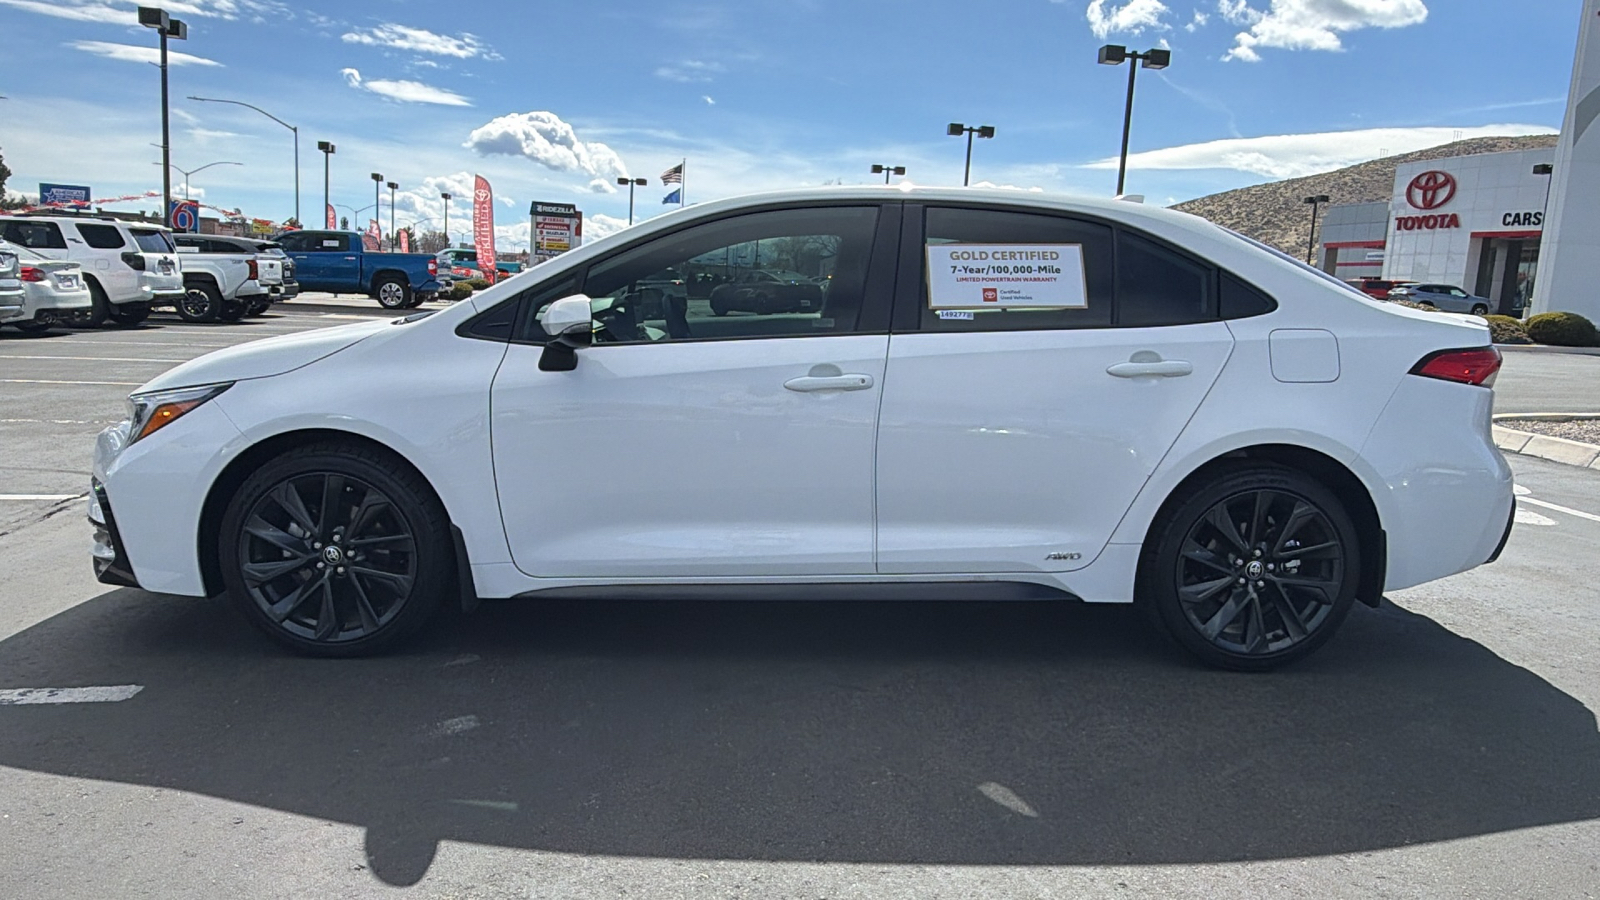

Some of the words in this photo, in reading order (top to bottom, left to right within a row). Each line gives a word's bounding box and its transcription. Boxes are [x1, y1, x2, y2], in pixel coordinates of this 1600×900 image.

[542, 205, 575, 214] RIDEZILLA
[172, 202, 194, 230] 6
[1502, 211, 1543, 226] CARS
[1395, 213, 1460, 231] TOYOTA
[950, 251, 989, 261] GOLD
[991, 251, 1060, 261] CERTIFIED
[950, 265, 1061, 275] 7-Year/100,000-Mile
[1044, 551, 1082, 561] AWD
